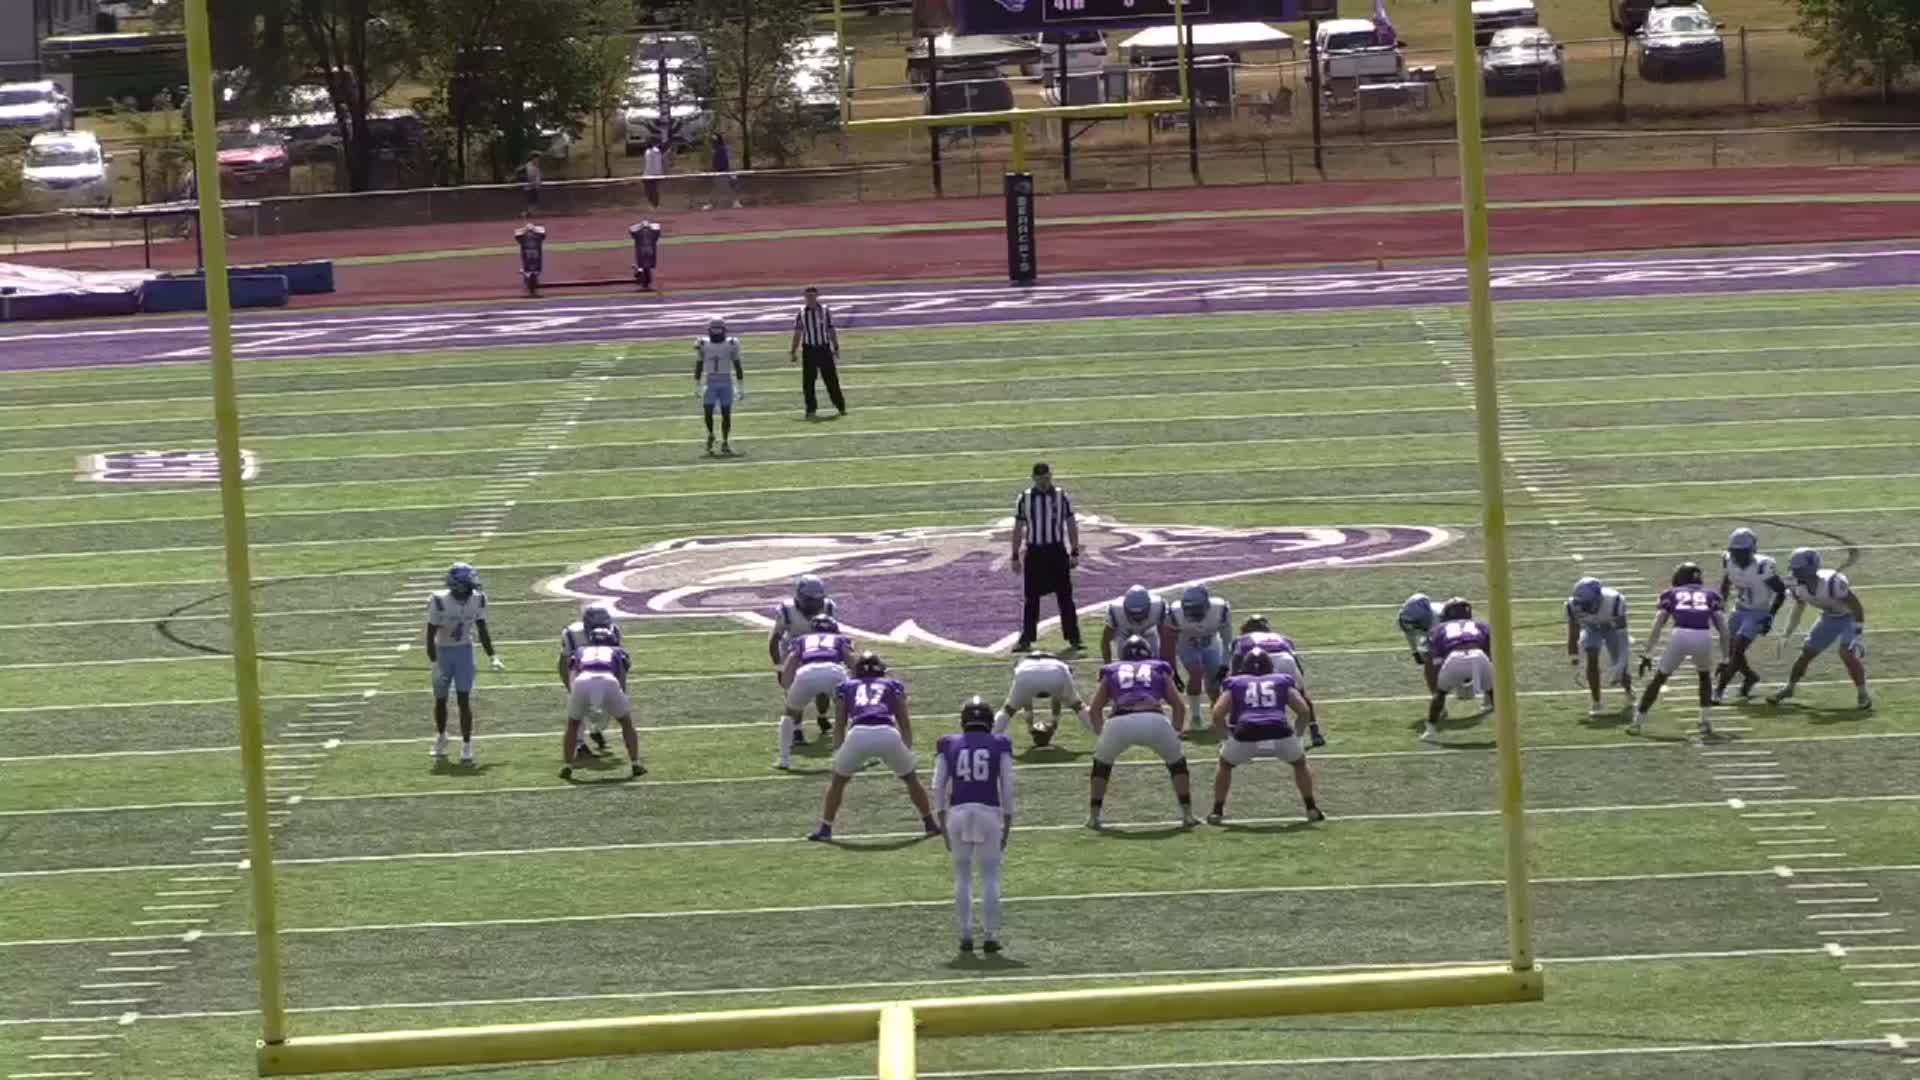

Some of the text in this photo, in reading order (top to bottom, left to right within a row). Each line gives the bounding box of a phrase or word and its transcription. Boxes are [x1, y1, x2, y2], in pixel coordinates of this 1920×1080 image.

[1118, 663, 1152, 689] 64
[855, 683, 885, 707] 47
[1244, 681, 1276, 708] 45
[956, 748, 990, 783] 46
